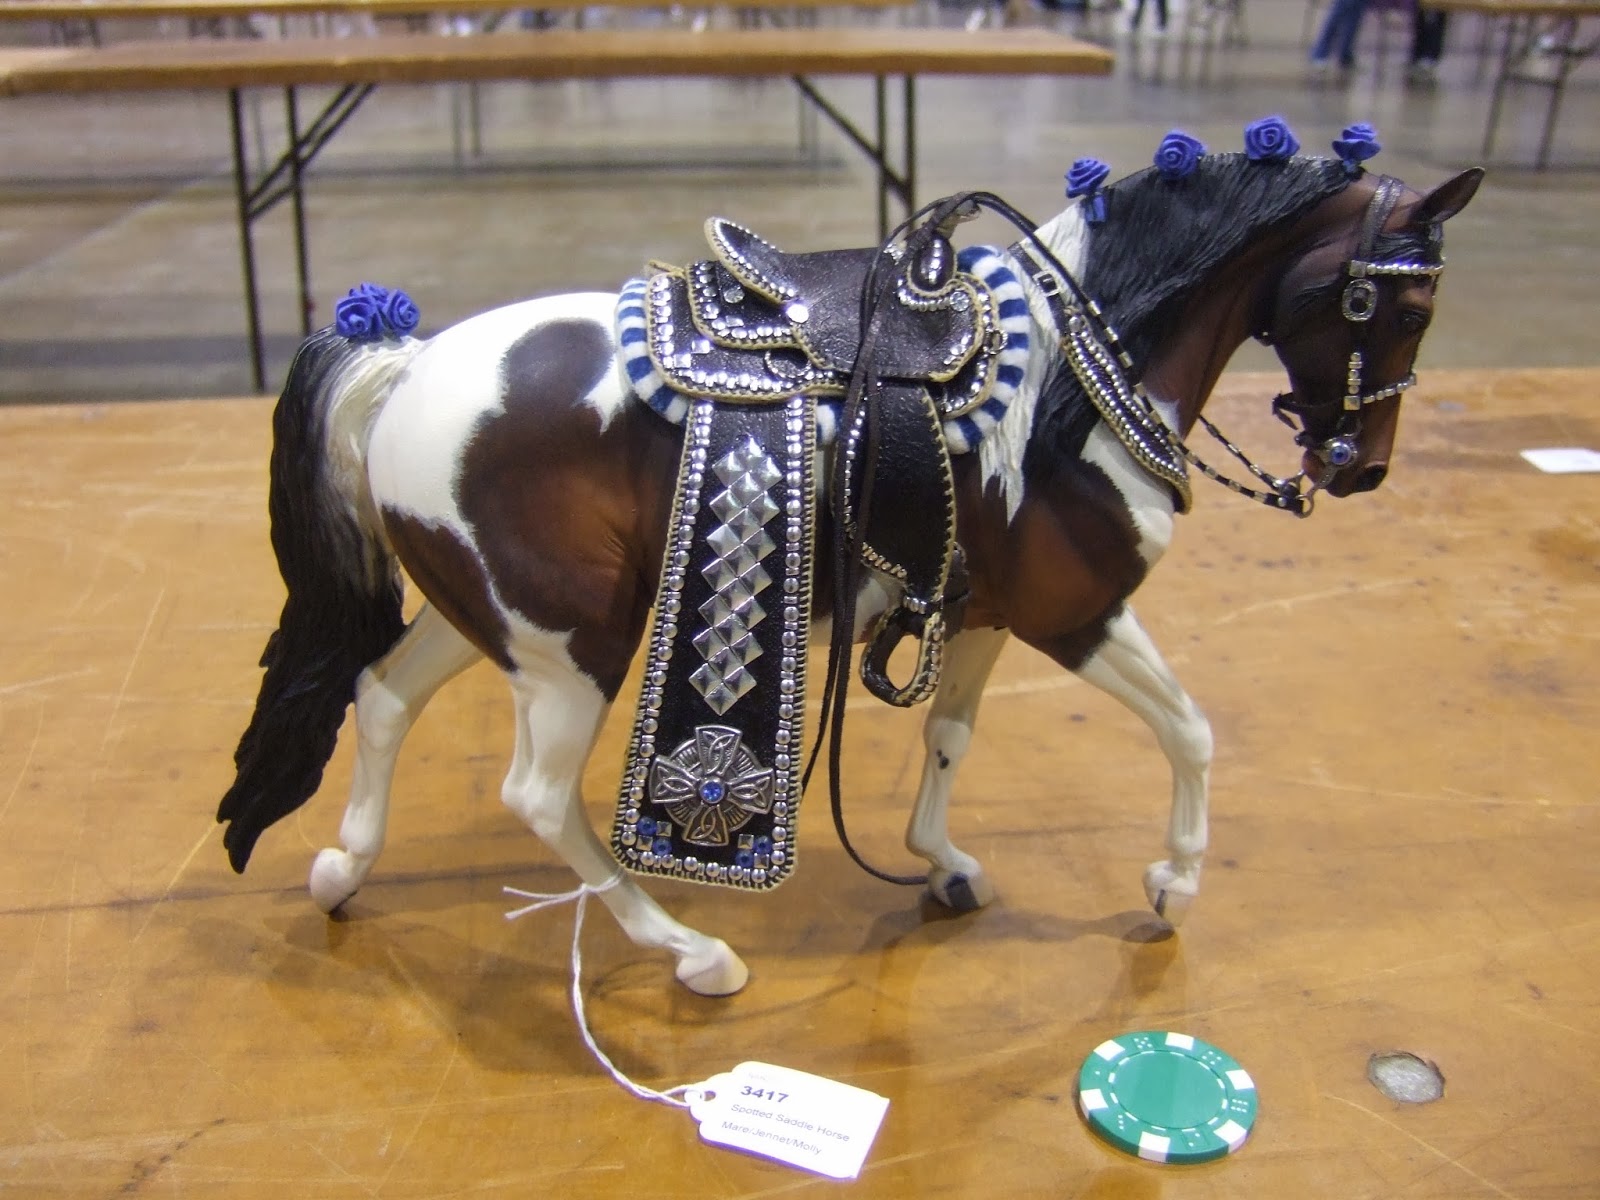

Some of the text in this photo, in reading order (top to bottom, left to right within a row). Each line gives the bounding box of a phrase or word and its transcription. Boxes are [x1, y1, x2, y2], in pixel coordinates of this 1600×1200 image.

[741, 1085, 789, 1103] 3417
[721, 1121, 822, 1155] Mare/Jennet/Molly
[731, 1104, 850, 1142] Spotted Saddle Horse
